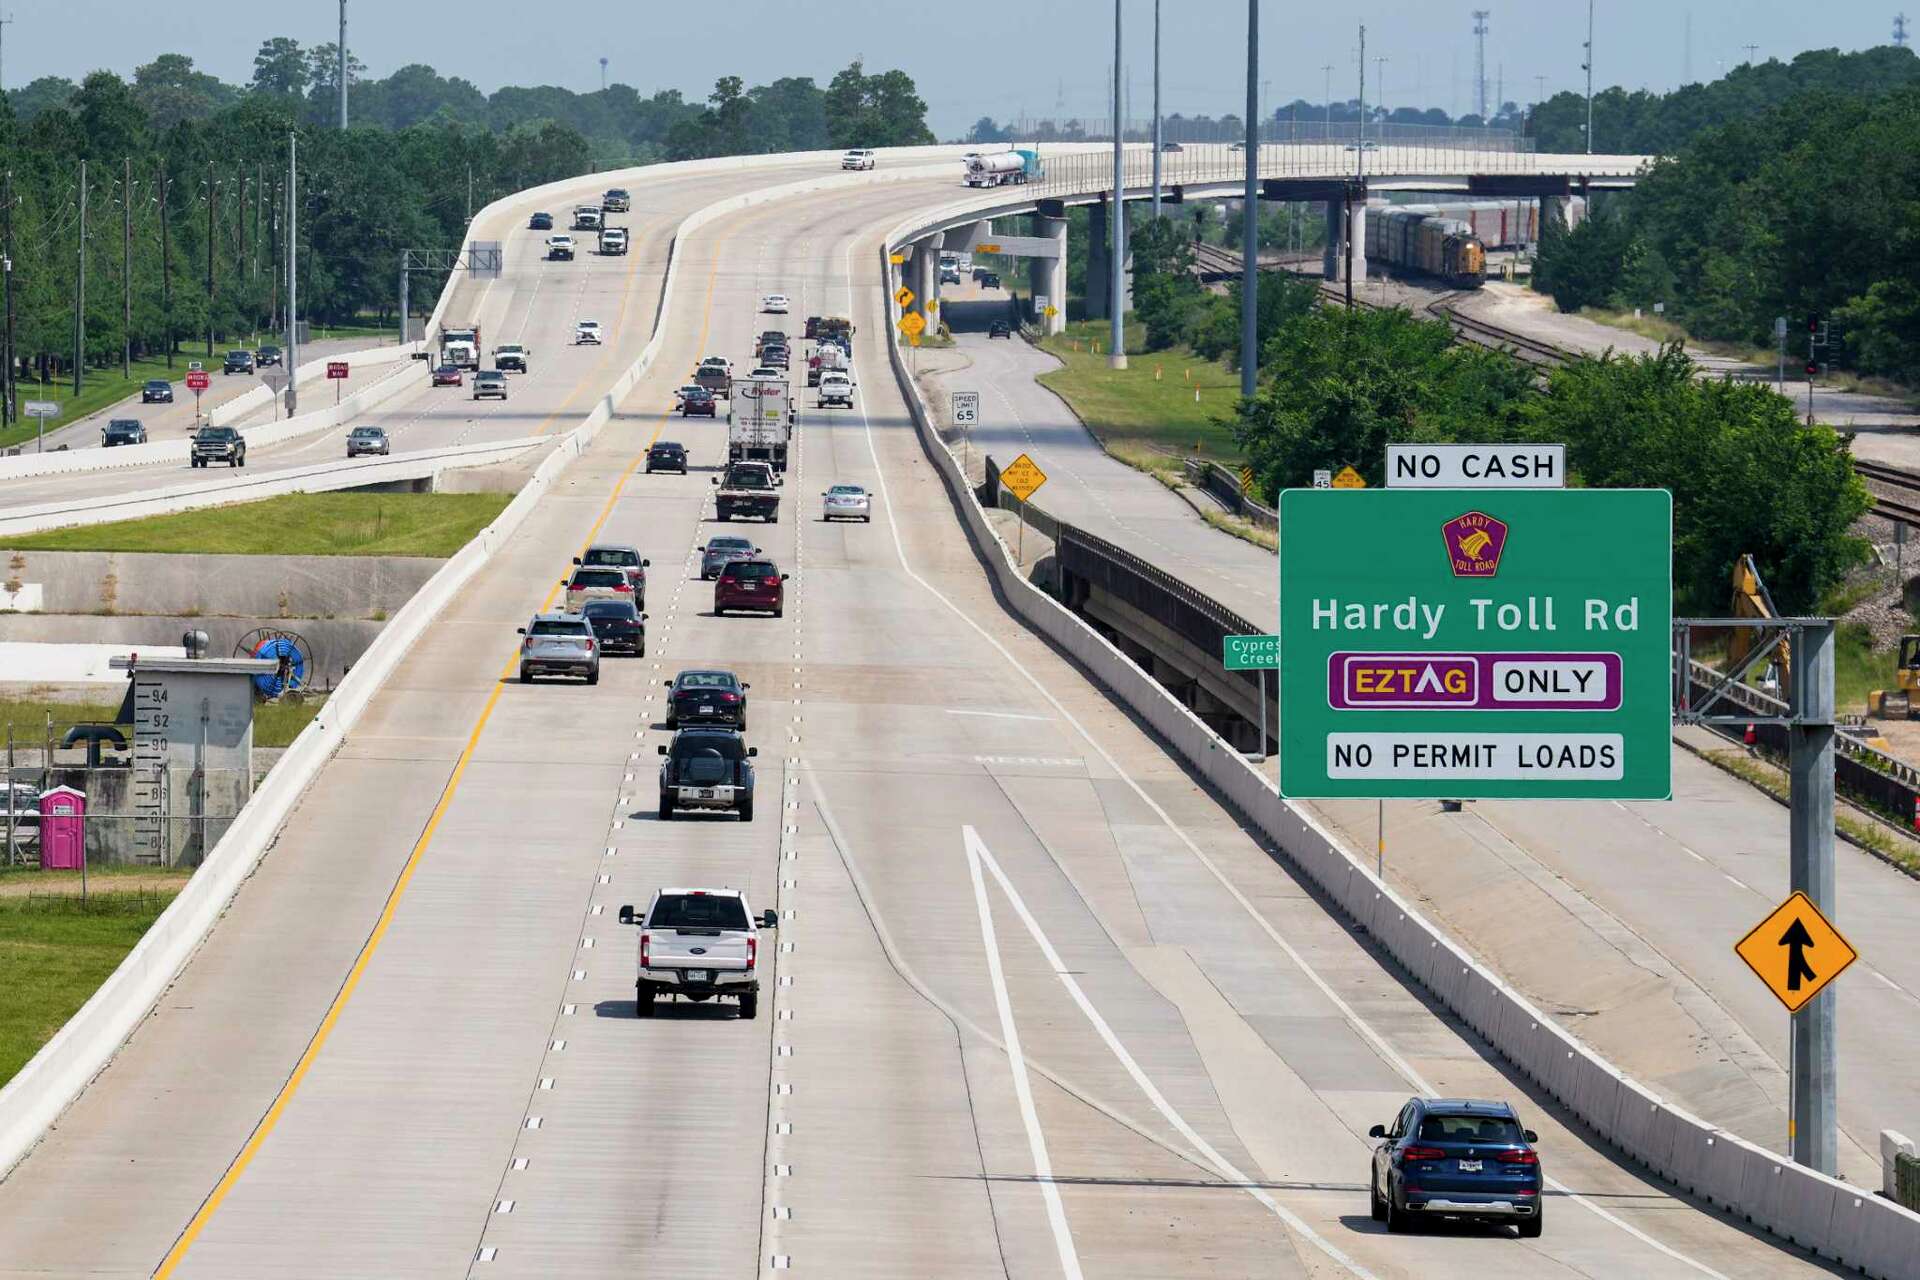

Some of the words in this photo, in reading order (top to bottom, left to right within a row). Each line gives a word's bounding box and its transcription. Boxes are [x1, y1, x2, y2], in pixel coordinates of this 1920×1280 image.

[751, 387, 781, 396] Ryder
[957, 410, 974, 420] 65
[1397, 455, 1441, 478] NO
[1461, 455, 1554, 479] CASH
[1315, 480, 1329, 488] 45
[1459, 516, 1490, 529] HARDY
[1456, 560, 1472, 571] TOLL
[1475, 560, 1495, 571] ROAD
[1312, 597, 1445, 639] Hardy
[1470, 597, 1556, 631] Toll
[1585, 597, 1639, 631] Rd
[1356, 663, 1467, 694] EZTAG
[1504, 669, 1593, 693] ONLY
[152, 690, 168, 703] 94
[154, 714, 168, 727] 92
[152, 739, 168, 751] 90
[1335, 744, 1372, 768] NO
[1393, 744, 1496, 768] PERMIT
[1518, 744, 1615, 768] LOADS
